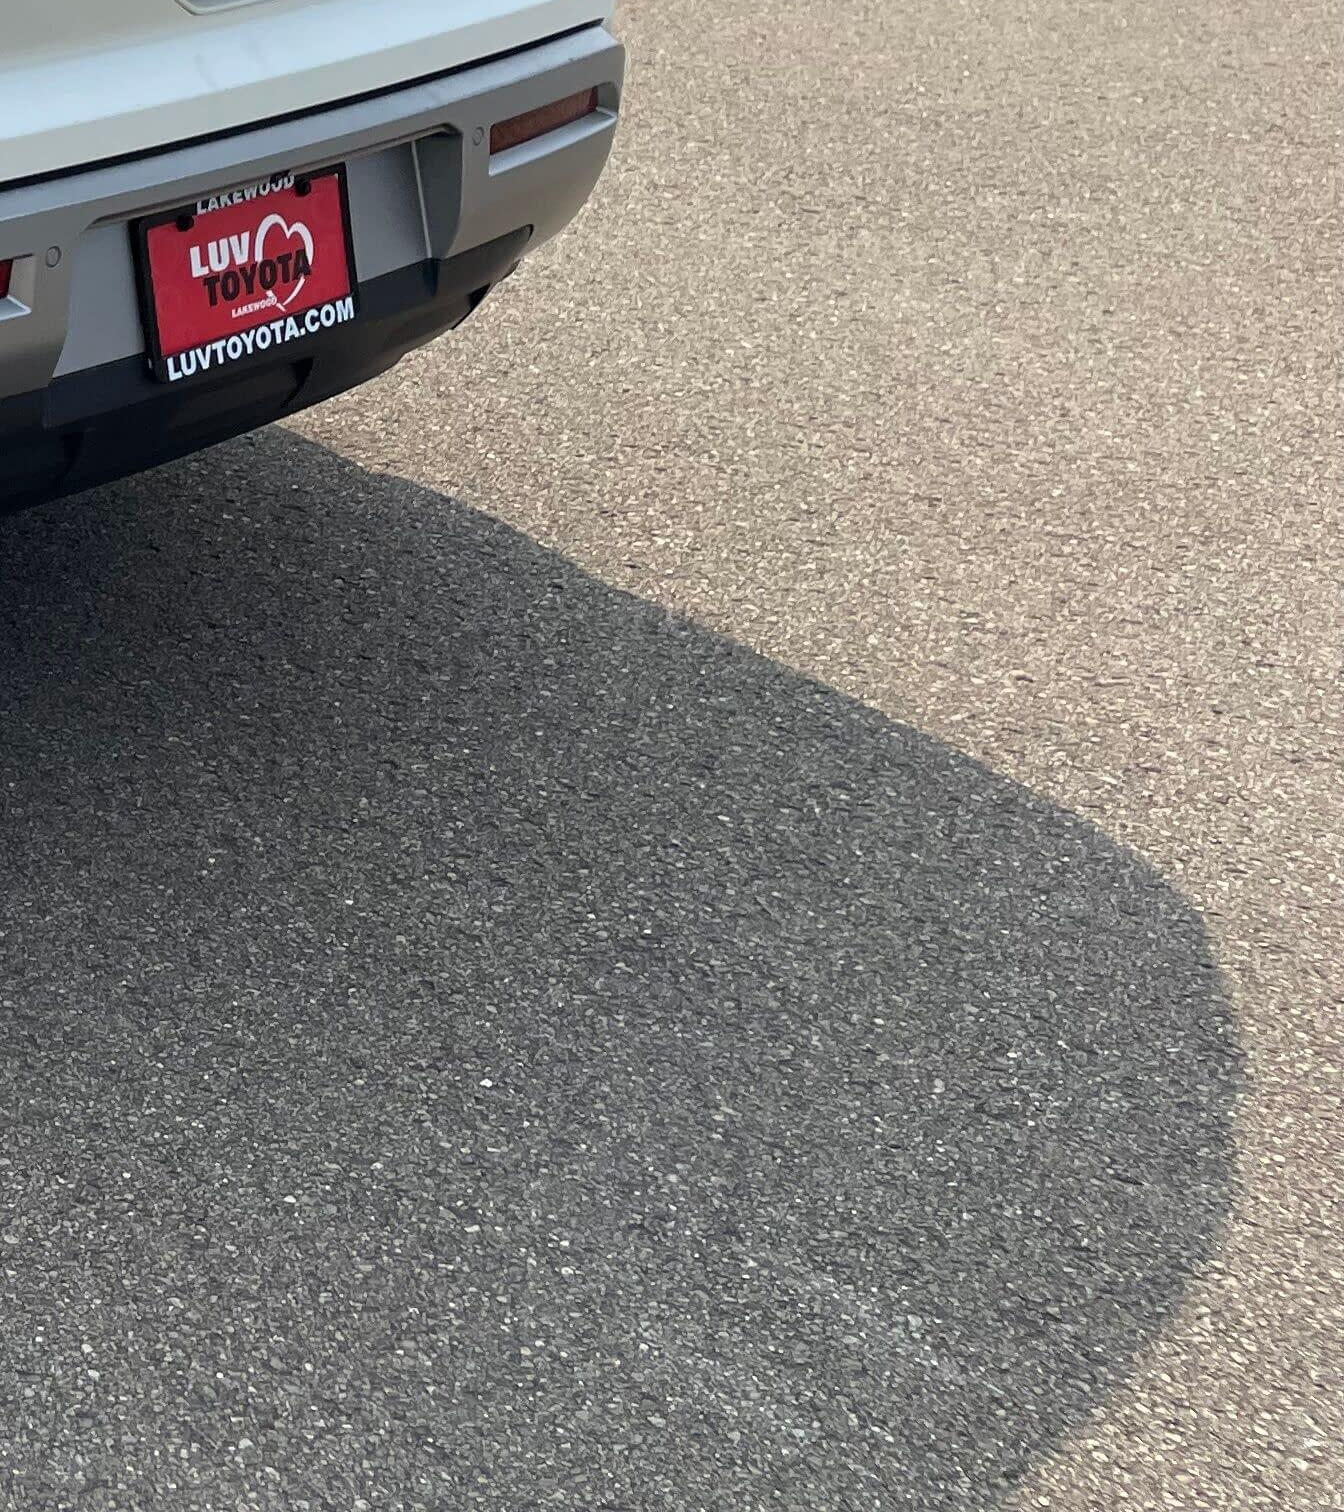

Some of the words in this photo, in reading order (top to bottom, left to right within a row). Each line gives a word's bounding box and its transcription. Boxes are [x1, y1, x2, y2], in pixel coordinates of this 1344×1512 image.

[195, 173, 295, 216] LAKEWOOD
[189, 230, 252, 278] LUV
[203, 248, 312, 307] TOYOTA
[166, 296, 355, 382] LUVTOYOTA.COM
